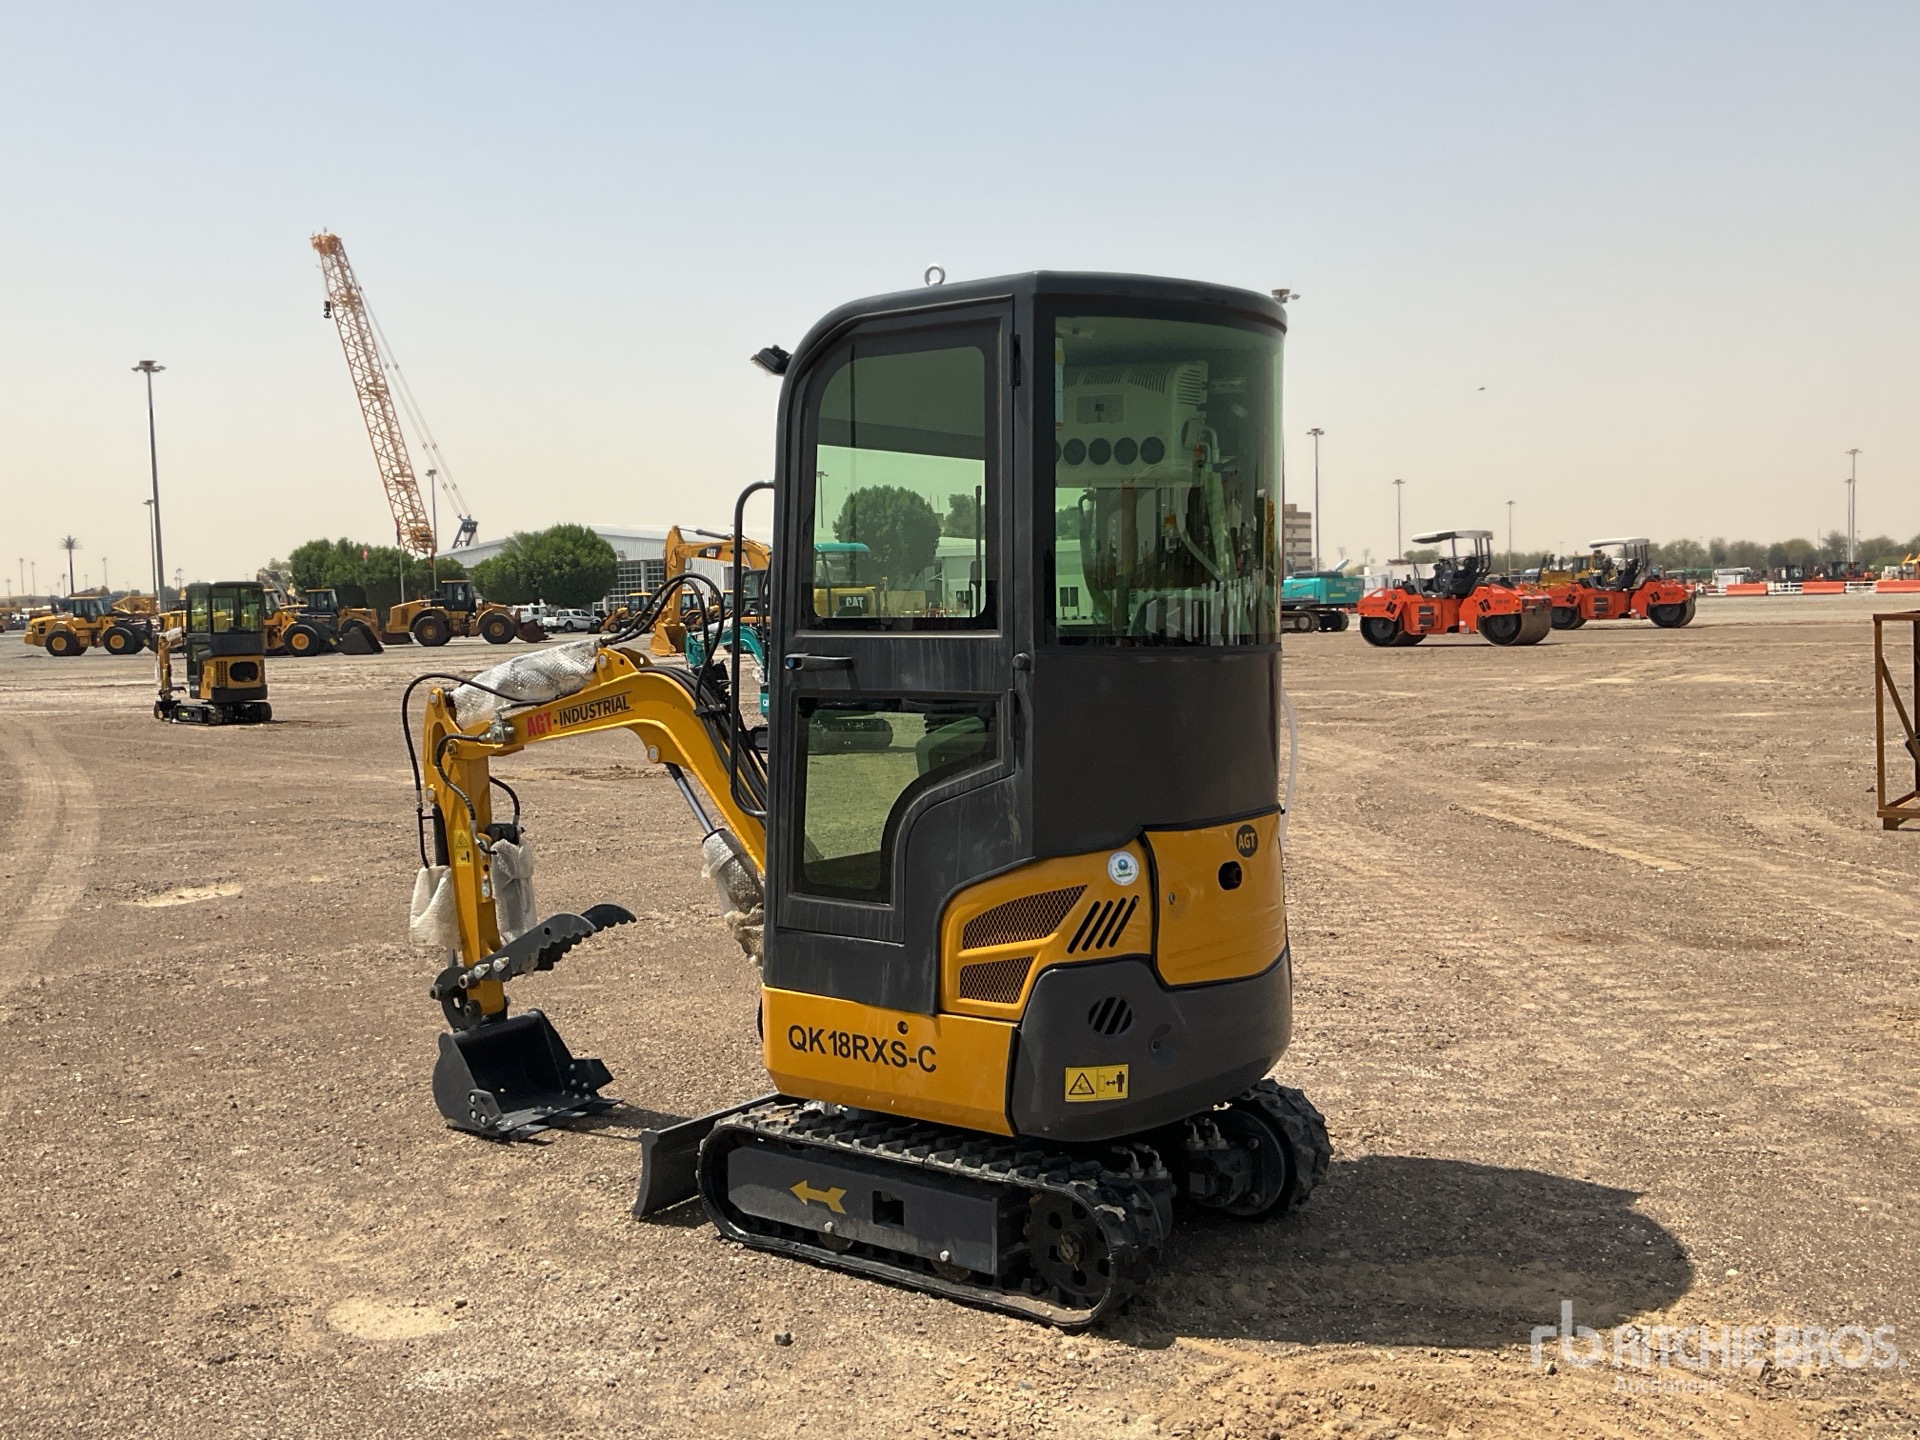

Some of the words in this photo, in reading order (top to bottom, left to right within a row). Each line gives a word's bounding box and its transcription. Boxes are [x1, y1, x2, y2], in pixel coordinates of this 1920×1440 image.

[845, 596, 864, 609] CAT
[527, 711, 553, 737] AGT
[559, 695, 630, 727] INDUSTRIAL
[1237, 832, 1256, 850] AGT
[788, 1024, 937, 1073] QK18RXS-C
